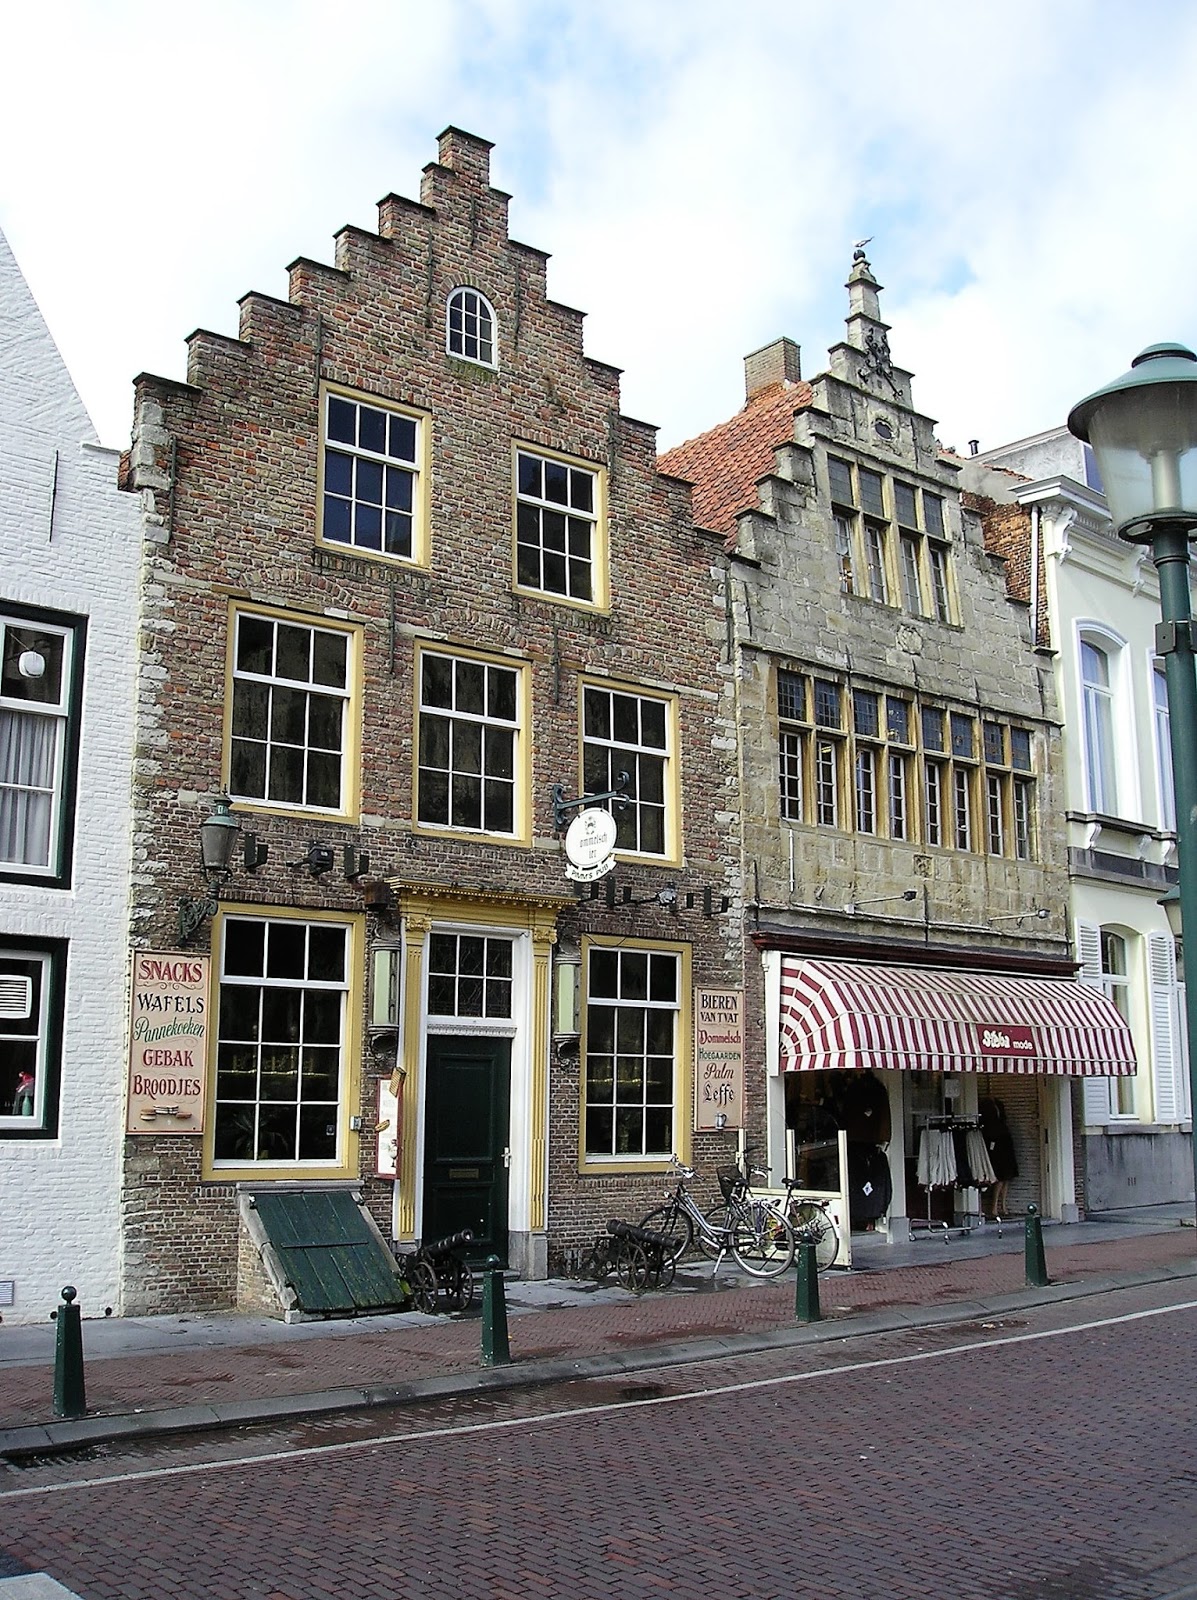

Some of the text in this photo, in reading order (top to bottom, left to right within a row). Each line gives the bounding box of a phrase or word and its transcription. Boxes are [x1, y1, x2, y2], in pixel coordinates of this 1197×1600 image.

[138, 959, 203, 983] SNACKS
[137, 992, 205, 1014] WAFELS
[701, 994, 738, 1011] BIEREN
[700, 1011, 717, 1023] VAN
[132, 1016, 206, 1043] Pannekoeken
[698, 1029, 742, 1045] Dommelsch
[1012, 1040, 1034, 1050] mode
[142, 1048, 195, 1068] GEBAK
[703, 1062, 735, 1080] Palm
[132, 1074, 202, 1101] BROODJES
[703, 1082, 736, 1109] Leffe
